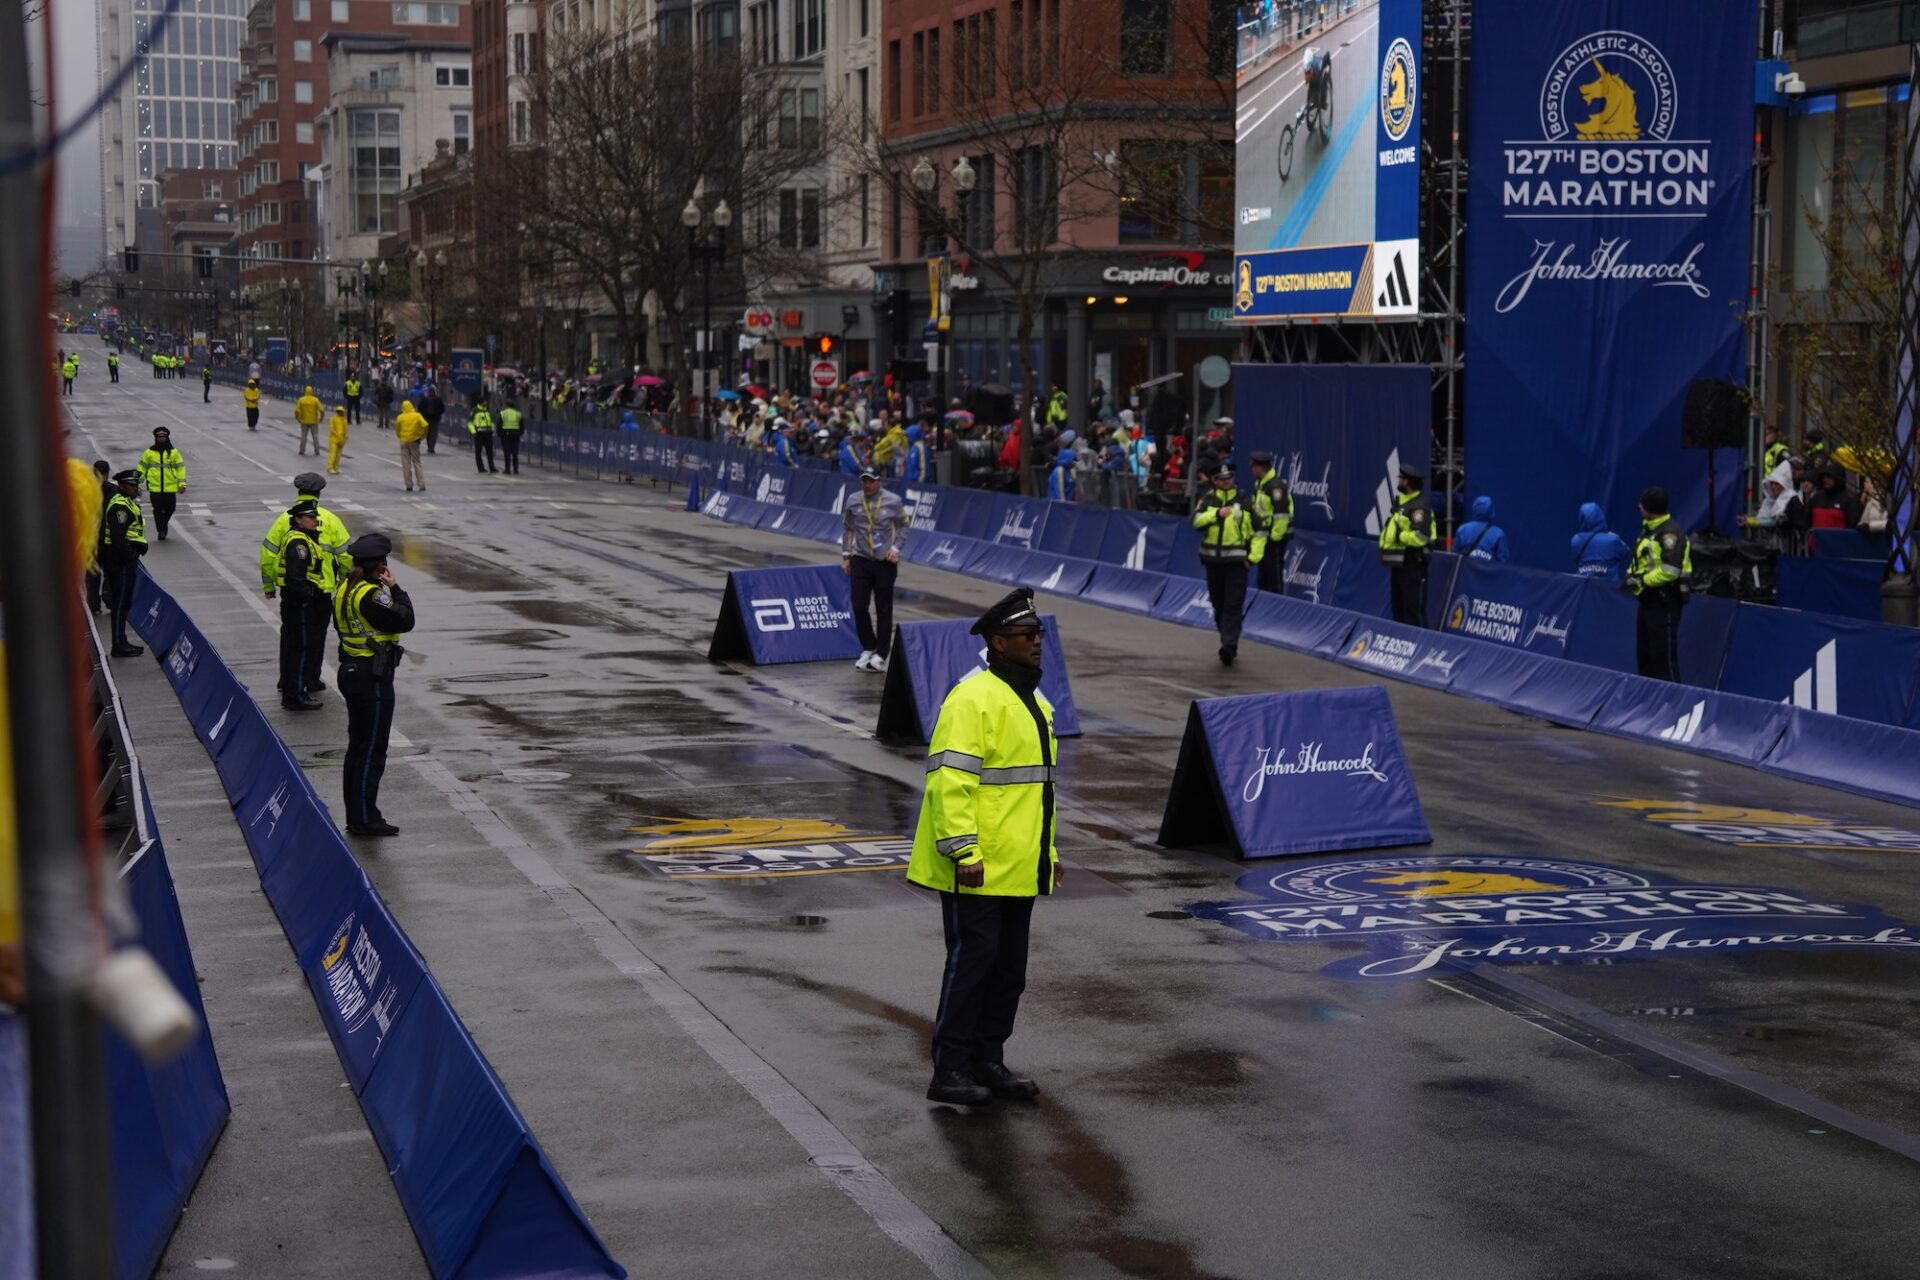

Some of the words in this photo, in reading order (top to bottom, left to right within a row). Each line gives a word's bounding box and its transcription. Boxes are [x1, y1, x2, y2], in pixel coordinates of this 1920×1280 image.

[1547, 69, 1567, 134] BOSTON
[1564, 37, 1628, 72] ATHLETIC
[1628, 43, 1672, 135] ASSOCIATION
[1379, 146, 1416, 167] WELCOME
[1504, 149, 1576, 174] 127TH
[1579, 149, 1709, 174] BOSTON
[1503, 180, 1708, 206] MARATHON
[1102, 266, 1175, 285] Capital
[1173, 267, 1211, 286] One
[1255, 275, 1274, 294] 127TH
[1274, 273, 1305, 293] BOSTON
[1306, 270, 1352, 291] MARATHON
[1495, 238, 1582, 313] John
[1581, 236, 1711, 298] Hancock
[794, 596, 828, 606] ABBOTT
[795, 604, 829, 613] WORLD
[1471, 598, 1490, 617] THE
[1487, 601, 1523, 625] BOSTON
[798, 612, 851, 621] MARATHON
[800, 620, 839, 630] MAJORS
[1465, 617, 1519, 644] MARATHON
[1372, 633, 1390, 650] THE
[1385, 638, 1418, 658] BOSTON
[1243, 746, 1297, 802] John
[1295, 740, 1389, 783] Hancock
[646, 839, 915, 865] ONE
[657, 854, 913, 873] BOSTO
[1300, 858, 1441, 879] ATHLETIC
[1227, 901, 1427, 920] 127TH
[1435, 889, 1807, 911] BOSTON
[1256, 901, 1849, 932] MARATHON
[1358, 936, 1584, 977] John
[1586, 927, 1920, 952] Hancock
[327, 957, 367, 1022] MARATHON
